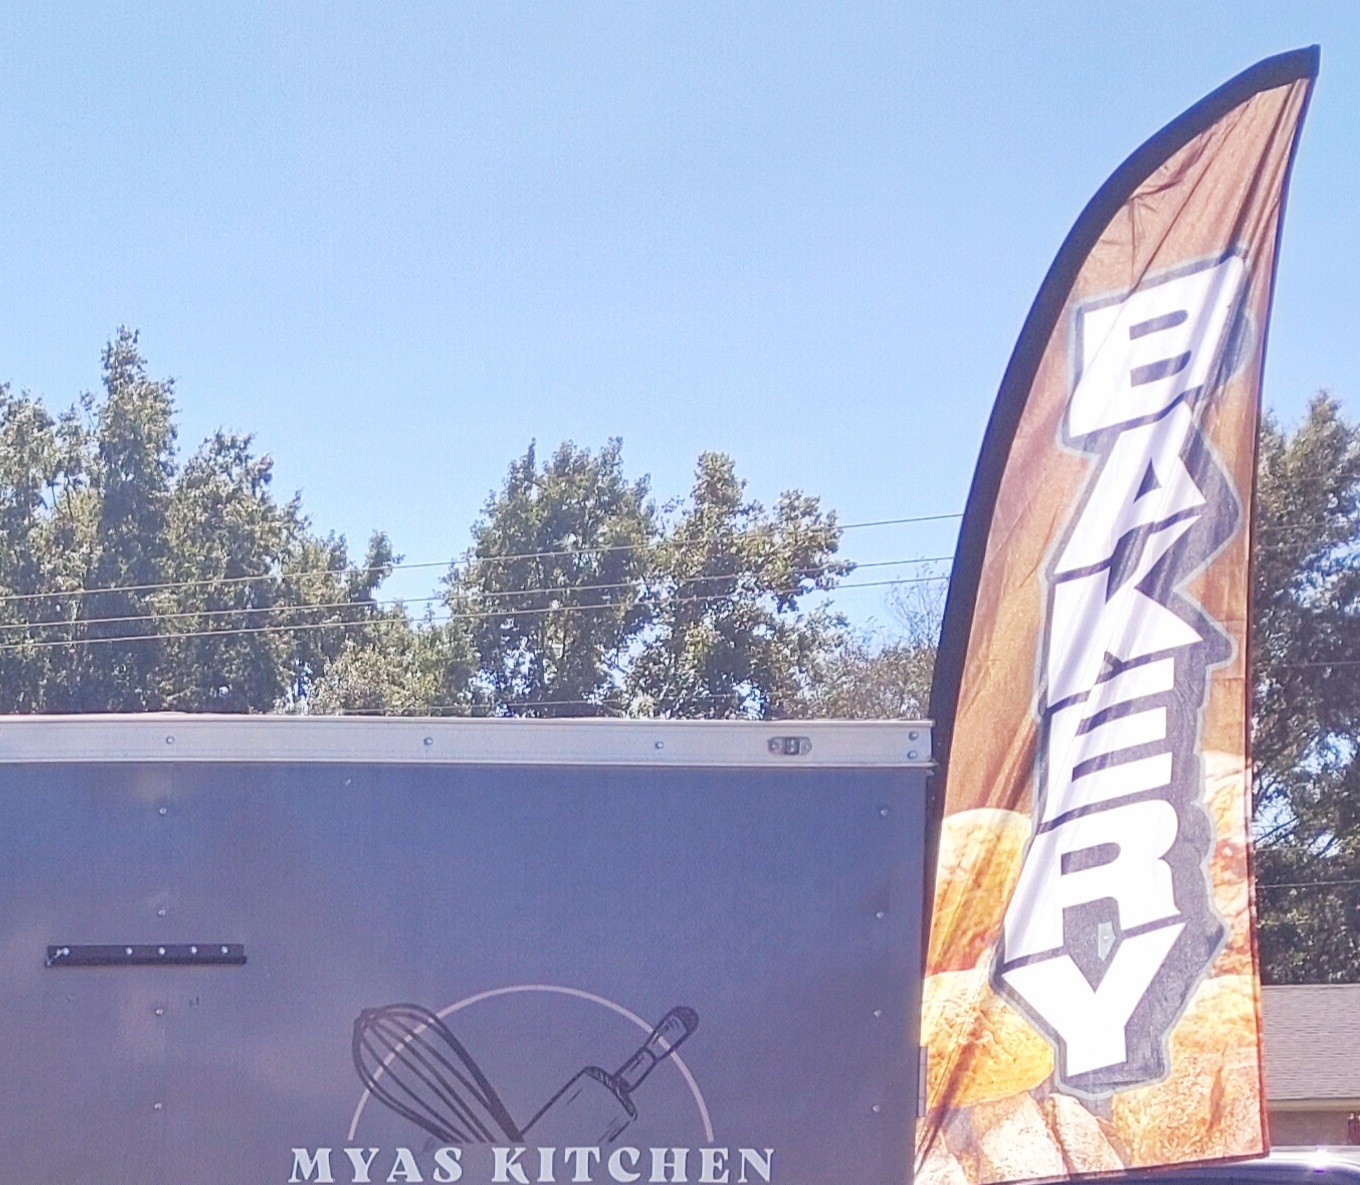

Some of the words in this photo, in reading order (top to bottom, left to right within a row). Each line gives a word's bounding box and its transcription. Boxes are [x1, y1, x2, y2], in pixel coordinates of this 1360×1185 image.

[1001, 254, 1246, 1078] BAKERY
[287, 1148, 463, 1184] MYAS
[491, 1147, 775, 1185] KITCHEN
